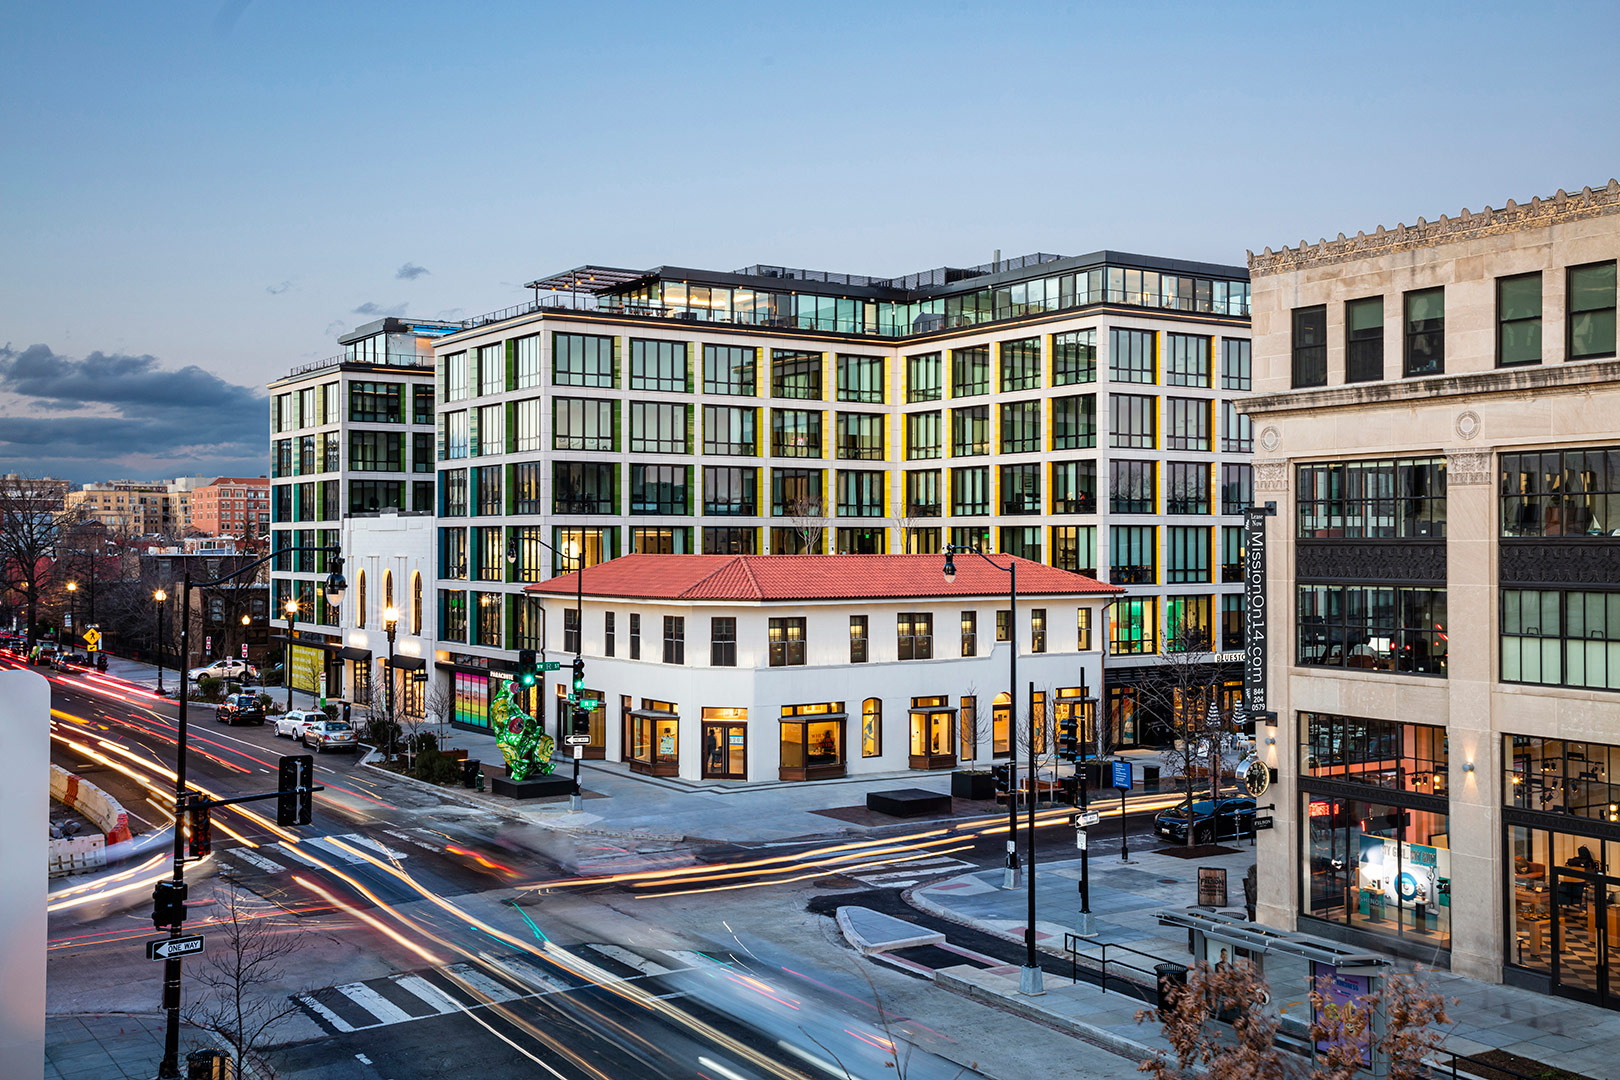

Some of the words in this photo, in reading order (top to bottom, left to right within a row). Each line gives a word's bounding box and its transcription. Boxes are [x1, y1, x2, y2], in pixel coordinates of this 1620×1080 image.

[1251, 532, 1265, 683] MissionOn14.com
[1251, 703, 1265, 711] 0579
[184, 941, 199, 950] WAY
